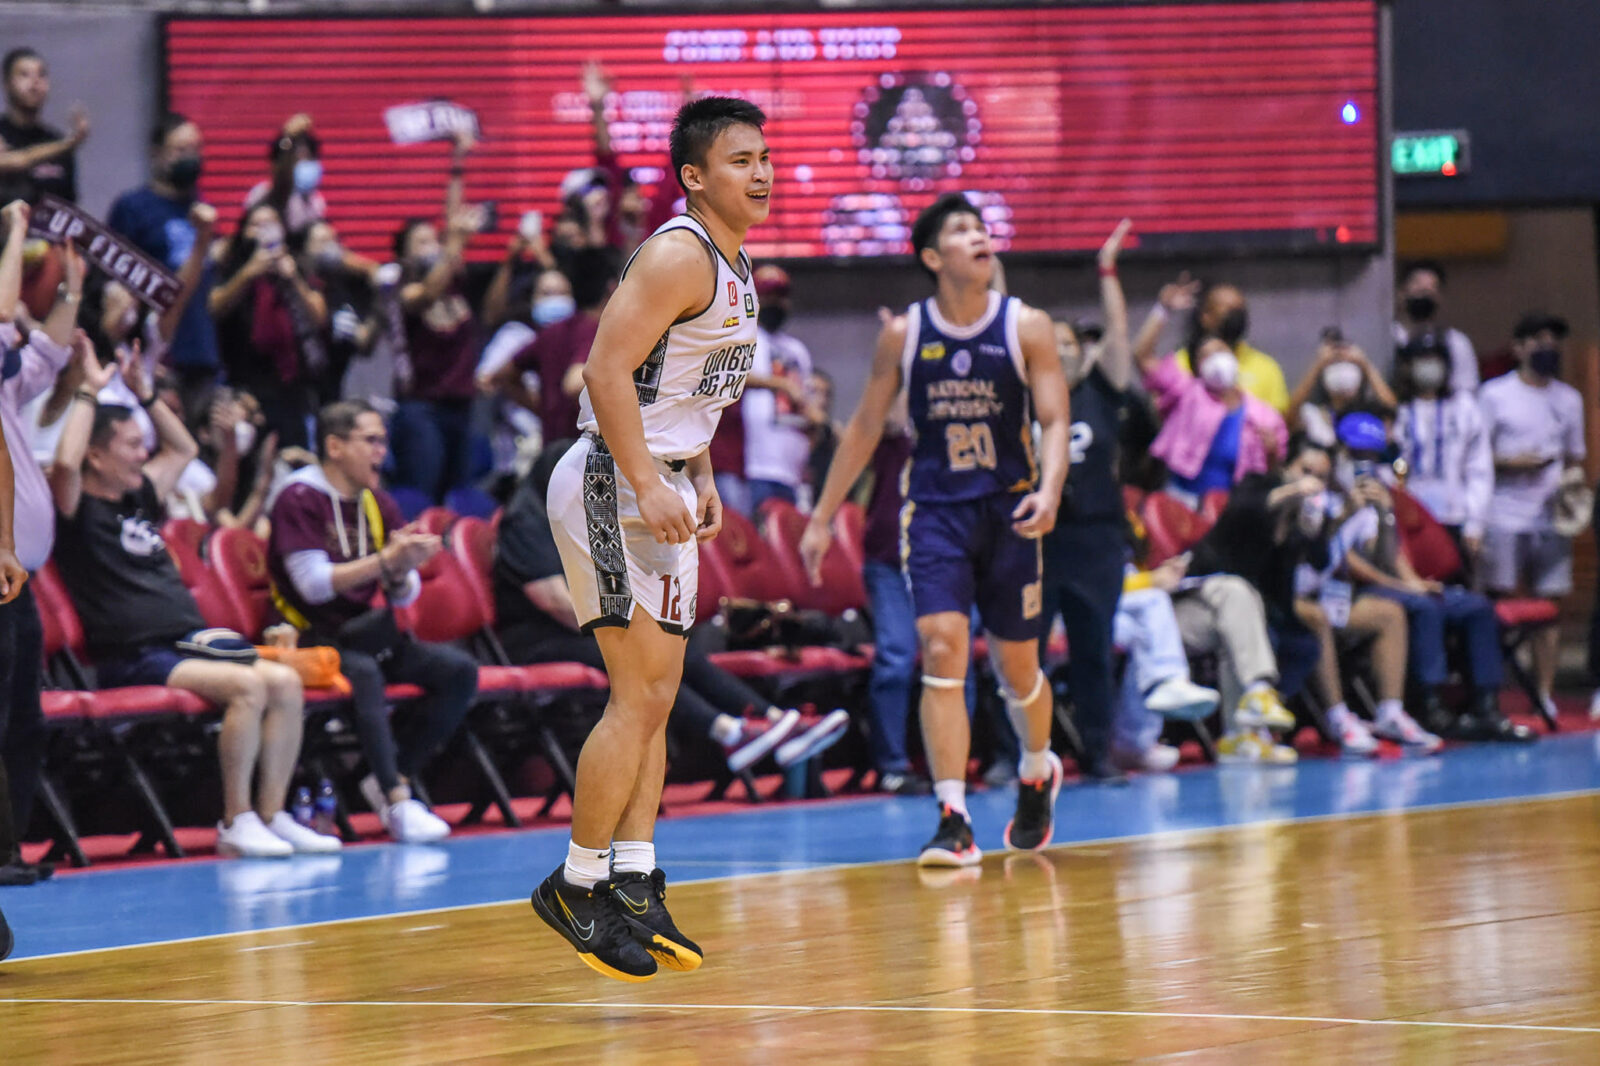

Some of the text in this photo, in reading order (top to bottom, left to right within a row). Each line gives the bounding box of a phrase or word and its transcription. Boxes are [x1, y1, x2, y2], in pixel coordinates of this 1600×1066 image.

[49, 210, 163, 296] UP FIGHT
[945, 422, 997, 472] 20
[659, 574, 681, 622] 12
